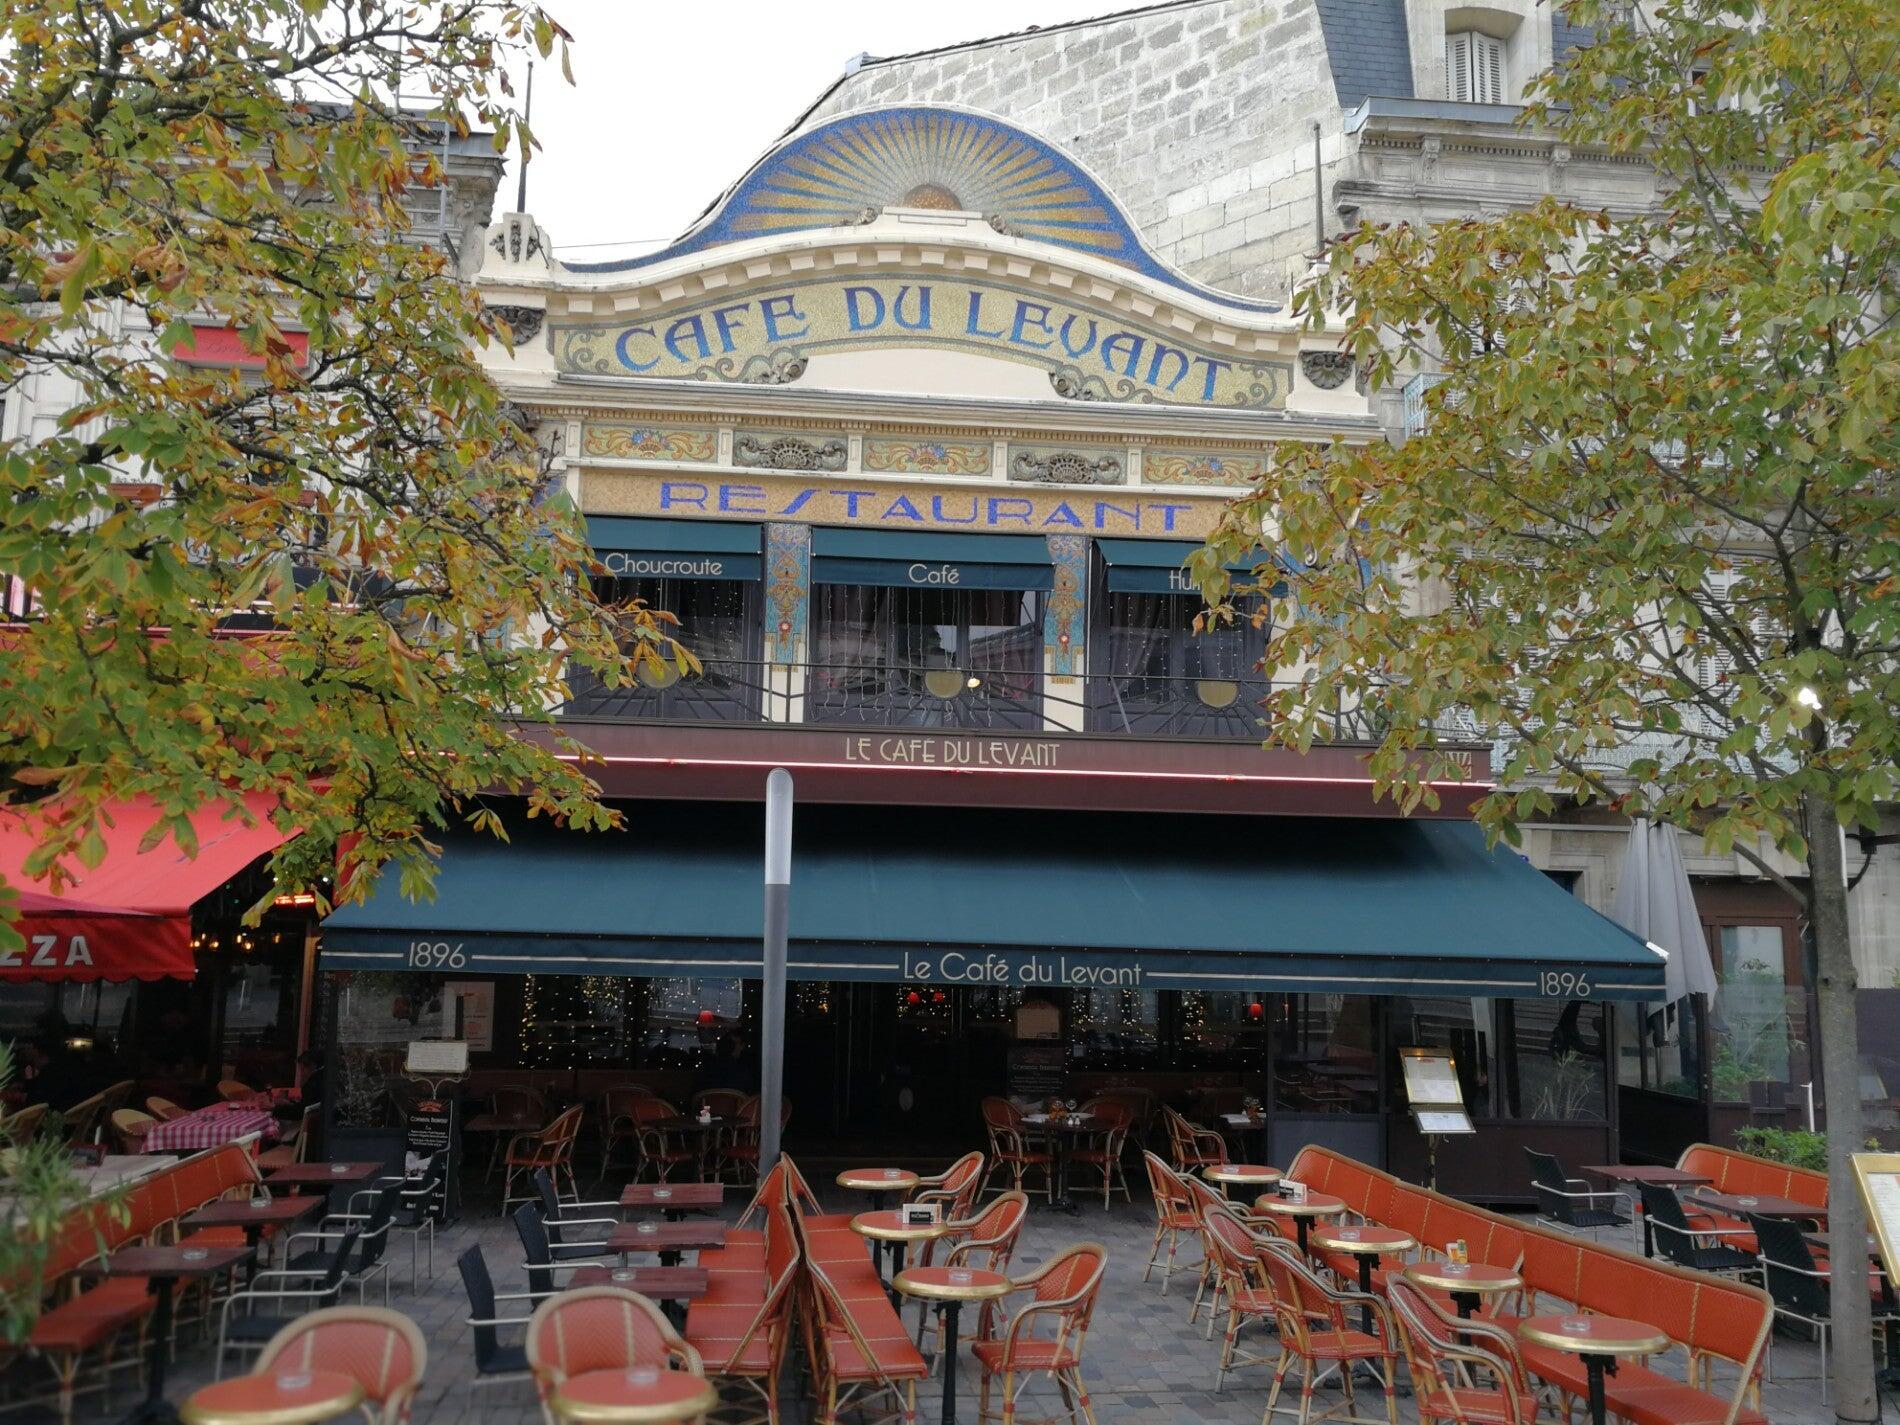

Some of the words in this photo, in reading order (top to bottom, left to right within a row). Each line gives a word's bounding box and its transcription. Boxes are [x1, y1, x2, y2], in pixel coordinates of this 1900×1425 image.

[615, 294, 809, 372] CAFE
[843, 285, 932, 333] DU
[965, 291, 1232, 402] LEVANT
[659, 481, 1194, 532] RESTAURANT
[604, 552, 723, 576] Choucroute
[908, 563, 960, 584] Café
[846, 737, 871, 761] LE
[943, 741, 970, 763] DU
[978, 742, 1060, 766] LEVANT
[408, 942, 466, 968] 1896
[904, 951, 932, 979] Le
[940, 952, 1010, 981] Café
[1018, 956, 1053, 983] du
[1060, 957, 1142, 986] Levant
[1540, 971, 1591, 997] 1896
